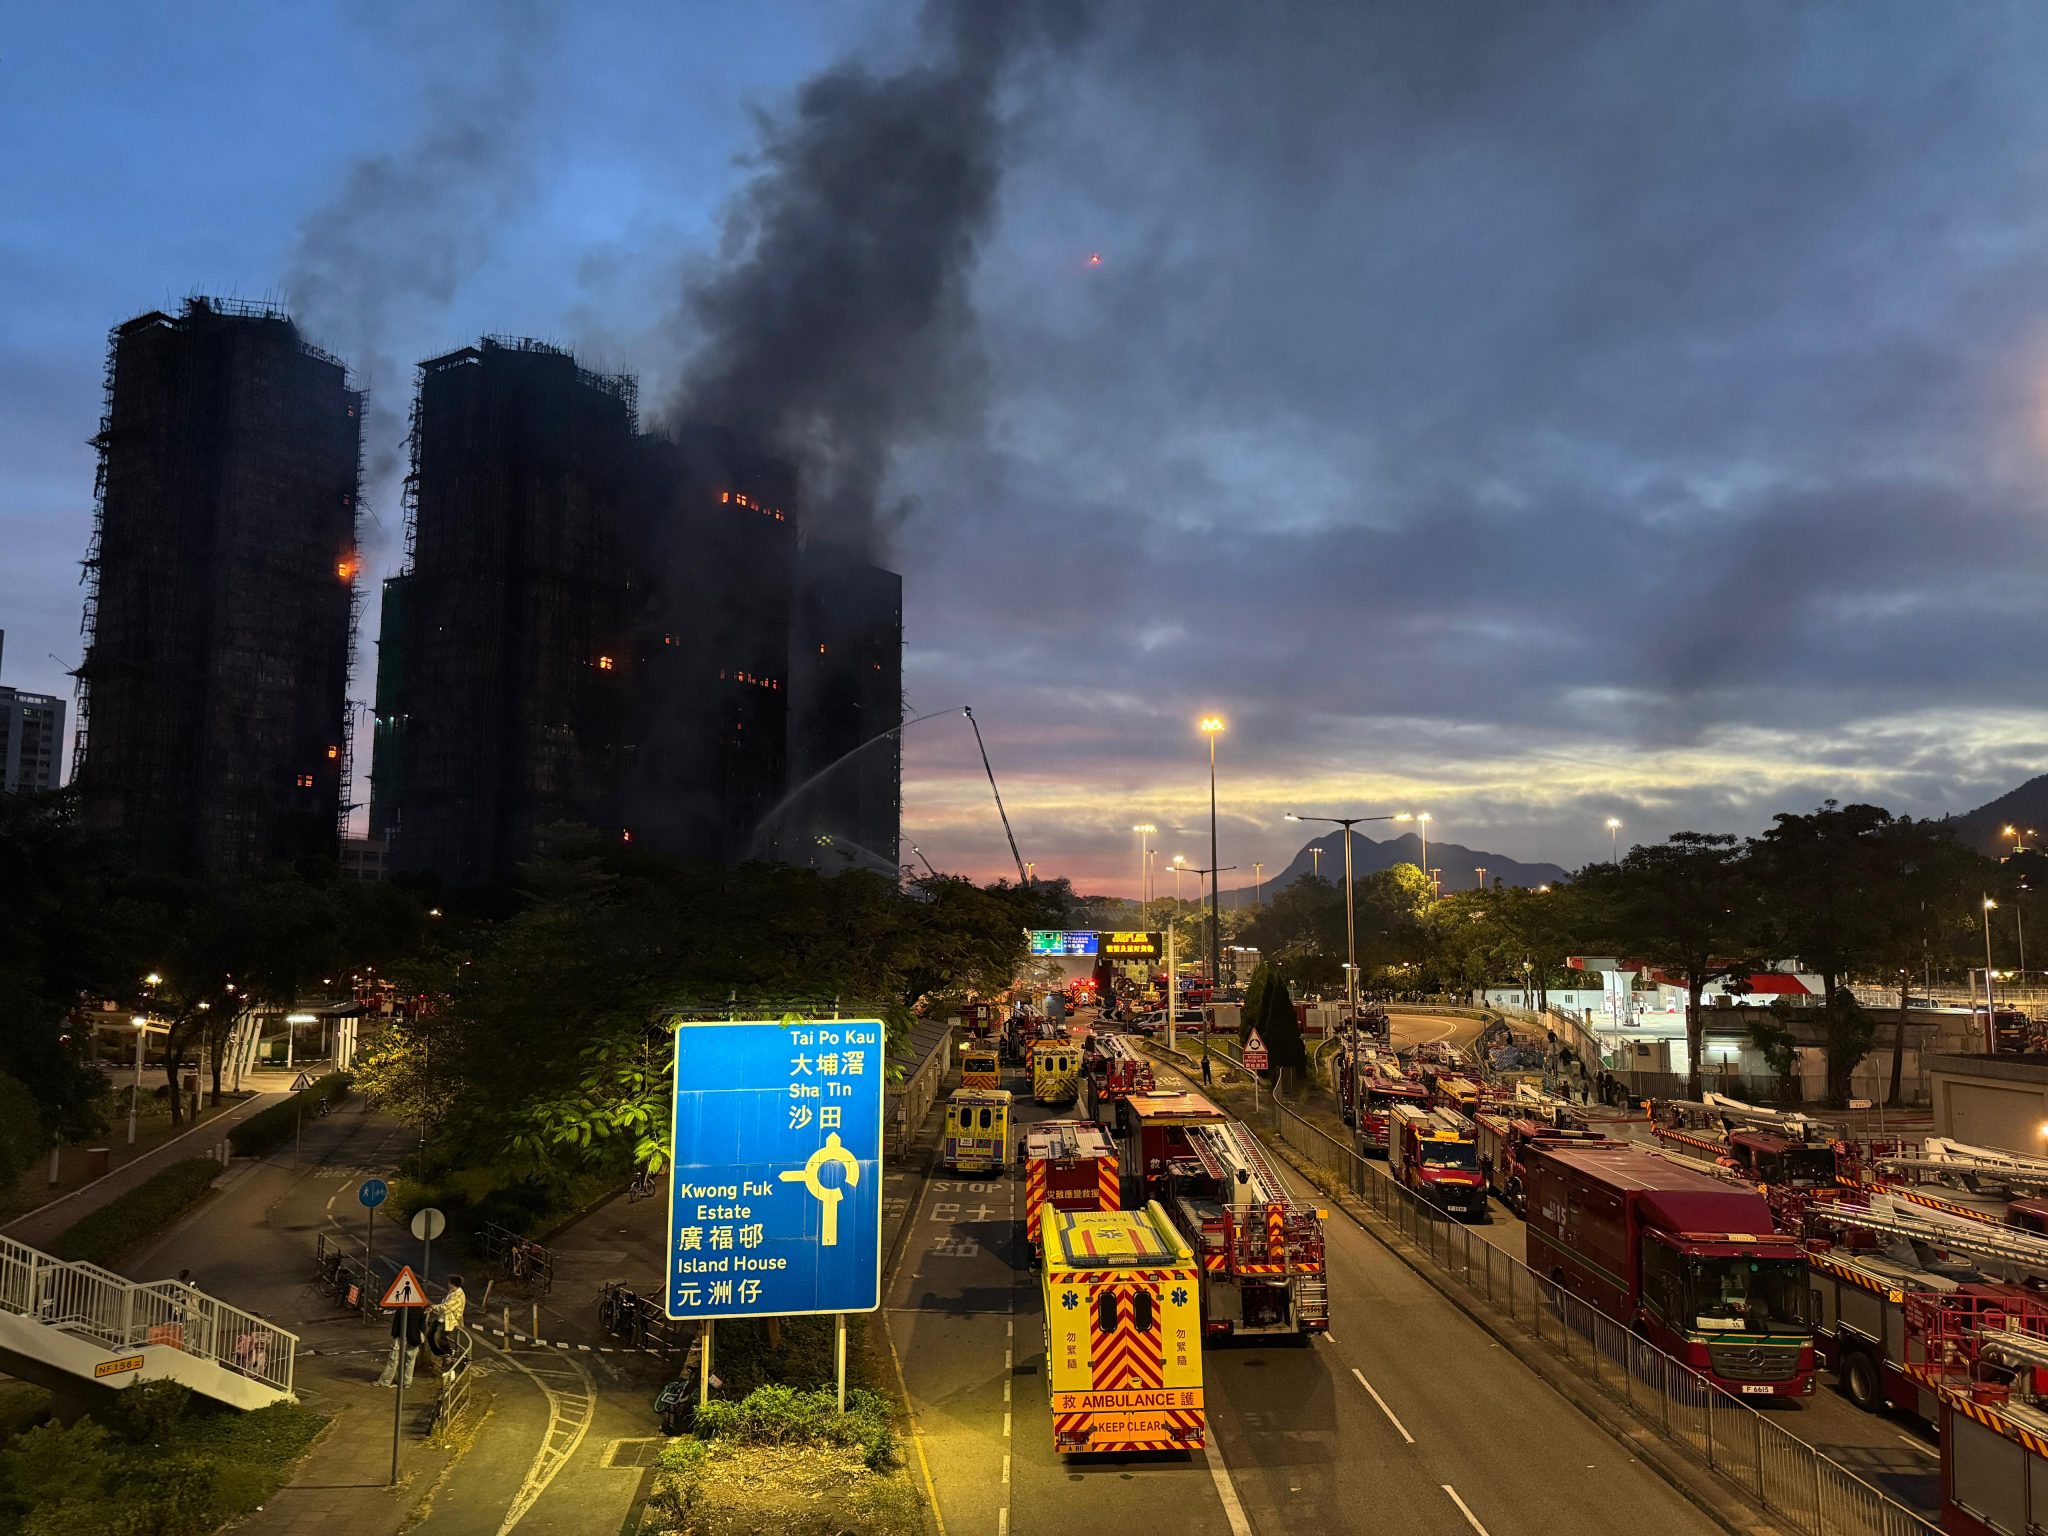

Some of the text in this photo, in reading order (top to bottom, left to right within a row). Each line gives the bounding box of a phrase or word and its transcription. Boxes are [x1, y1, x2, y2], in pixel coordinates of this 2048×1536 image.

[790, 1029, 875, 1045] Tai Po Kau
[790, 1051, 864, 1077] 大埔滘
[789, 1081, 852, 1099] Sha Tin
[788, 1105, 841, 1130] 沙田
[681, 1181, 773, 1200] Kwong Fuk
[932, 1182, 1002, 1193] STOP
[697, 1204, 751, 1220] Estate
[929, 1203, 996, 1223] 巴士
[678, 1224, 763, 1251] 廣福邨
[931, 1235, 979, 1257] 站
[678, 1256, 787, 1274] Island House
[677, 1279, 762, 1307] 元洲仔
[1066, 1332, 1077, 1370] 勿緊隨
[1176, 1329, 1187, 1366] 勿緊隨
[1062, 1392, 1195, 1409] 救 AMBULANCE 護
[1098, 1420, 1161, 1433] KEEP CLEAR
